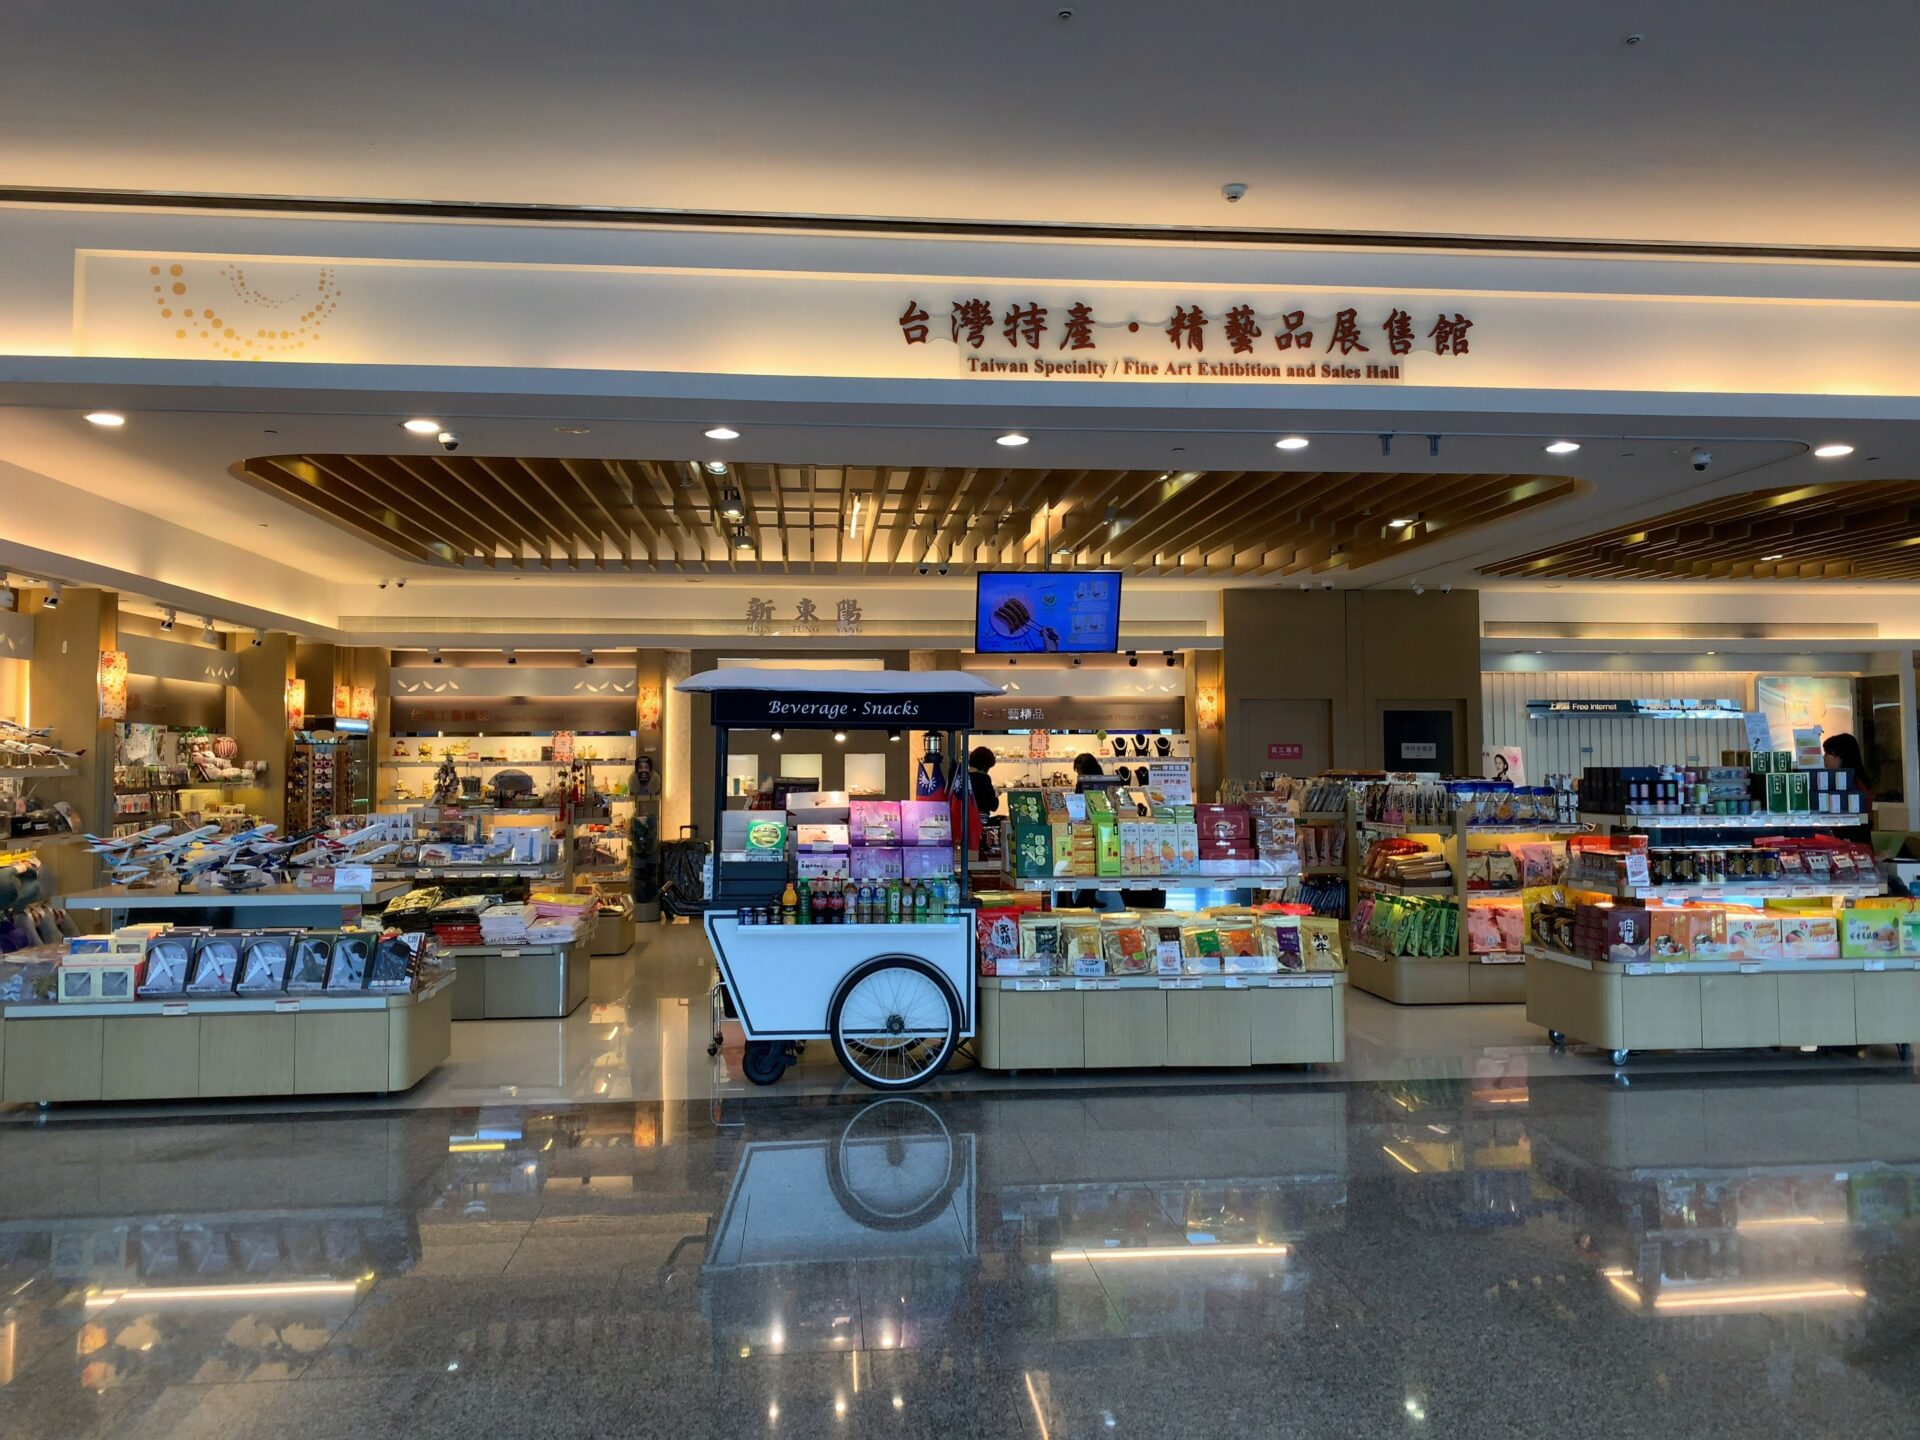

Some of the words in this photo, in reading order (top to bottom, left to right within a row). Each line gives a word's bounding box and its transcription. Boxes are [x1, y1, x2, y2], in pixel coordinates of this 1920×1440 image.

[967, 357, 1028, 373] Taiwan
[1034, 359, 1107, 378] Specialty
[1124, 359, 1159, 375] Fine
[1164, 361, 1192, 376] Art
[1198, 362, 1281, 377] Exhibition
[1287, 364, 1316, 378] and
[1321, 364, 1361, 379] Sales
[1366, 364, 1400, 379] Hall
[746, 597, 862, 625] 新東陽
[747, 625, 771, 633] HSIN
[792, 625, 819, 633] TUNG
[768, 700, 848, 719] Beverage
[862, 701, 919, 715] Snacks
[1573, 703, 1589, 711] Free
[1591, 703, 1617, 711] Internet
